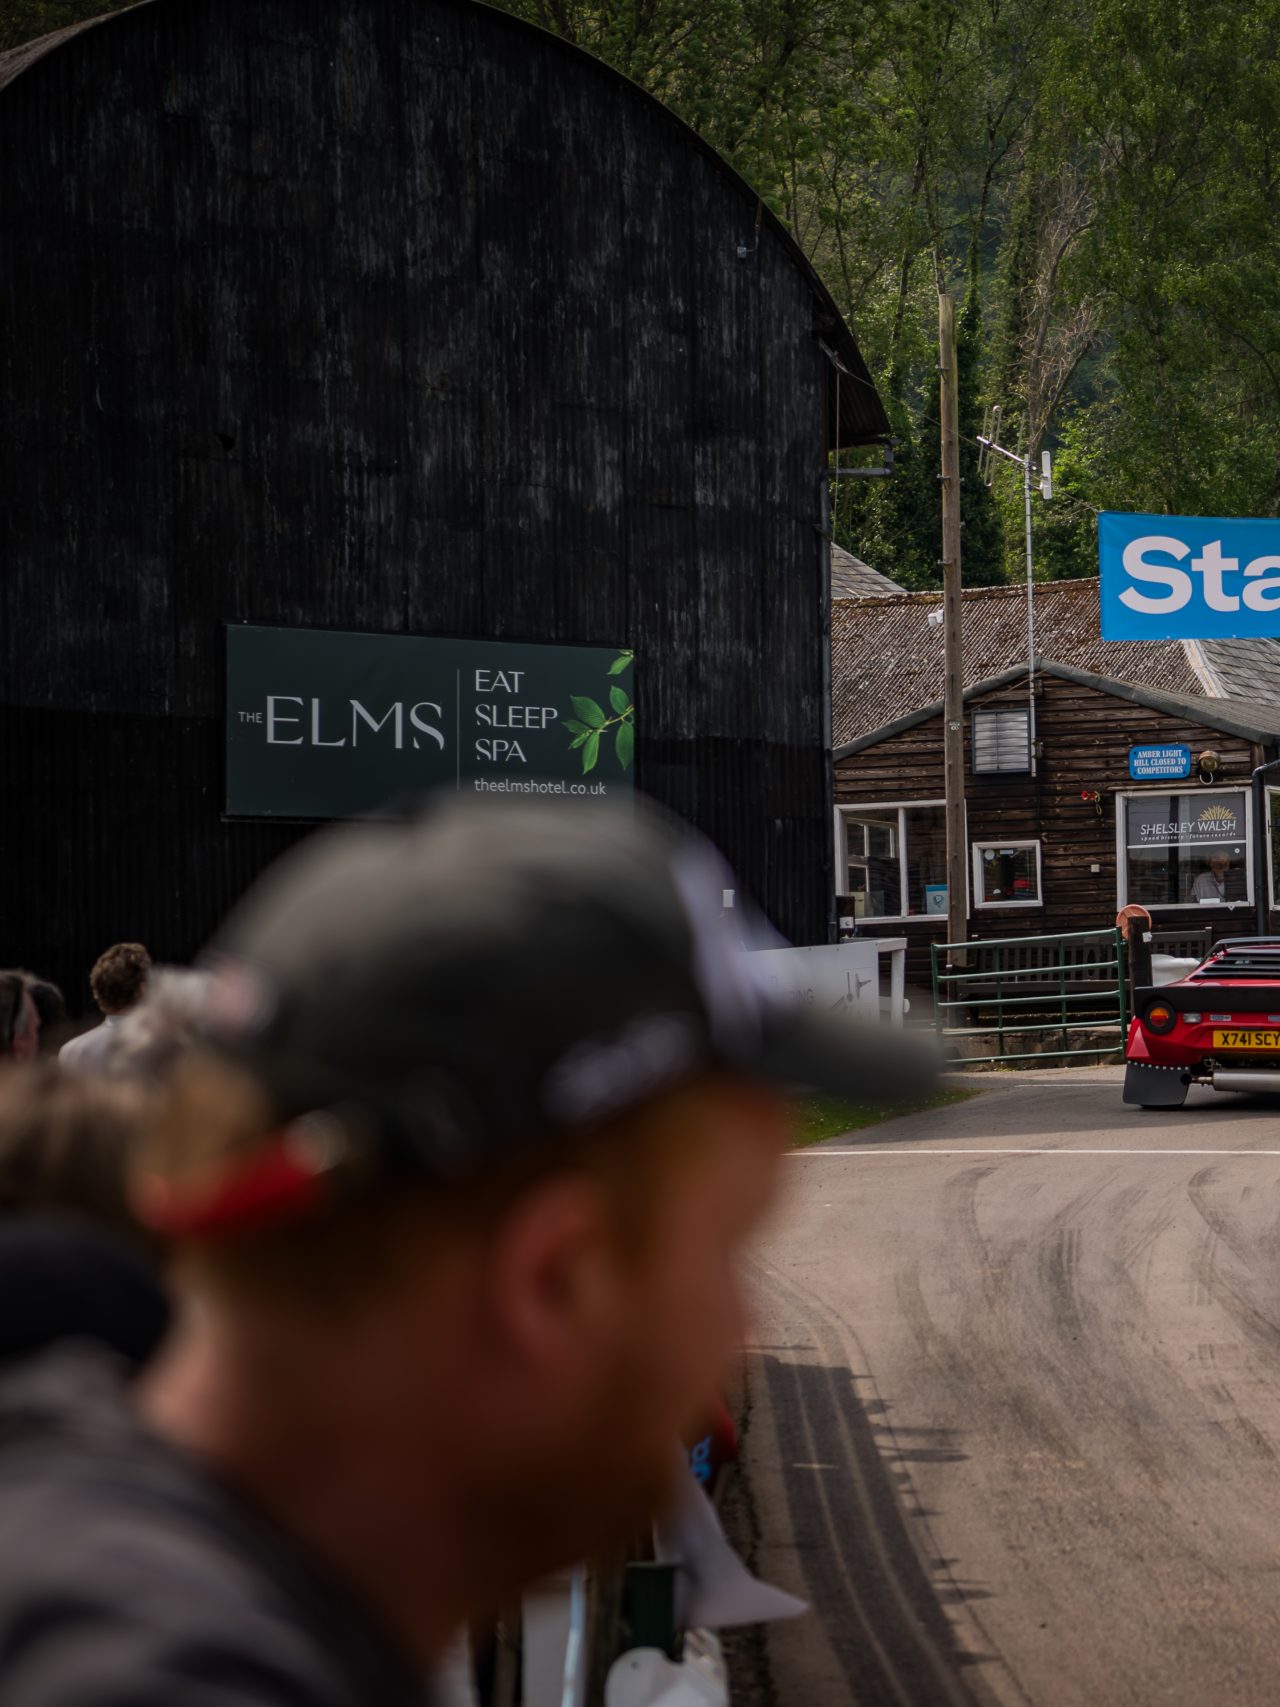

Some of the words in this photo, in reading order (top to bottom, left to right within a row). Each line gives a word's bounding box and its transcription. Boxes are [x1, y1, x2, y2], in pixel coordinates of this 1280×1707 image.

[474, 669, 525, 694] EAT
[238, 711, 263, 724] THE
[266, 695, 445, 751] ELMS
[474, 704, 558, 729] SLEEP
[474, 738, 527, 763] SPA
[1137, 750, 1161, 759] AMBER
[1162, 749, 1183, 757] LIGHT
[1134, 759, 1149, 767] HILL
[1151, 758, 1176, 766] CLOSED
[1177, 757, 1187, 765] TO
[1137, 765, 1183, 774] COMPETITORS
[474, 778, 607, 796] theelmshotel.co.uk
[1140, 822, 1195, 835] SHELSLEY
[1197, 820, 1236, 832] WALSH
[1222, 1033, 1251, 1046] X741
[1255, 1033, 1280, 1046] SCY
